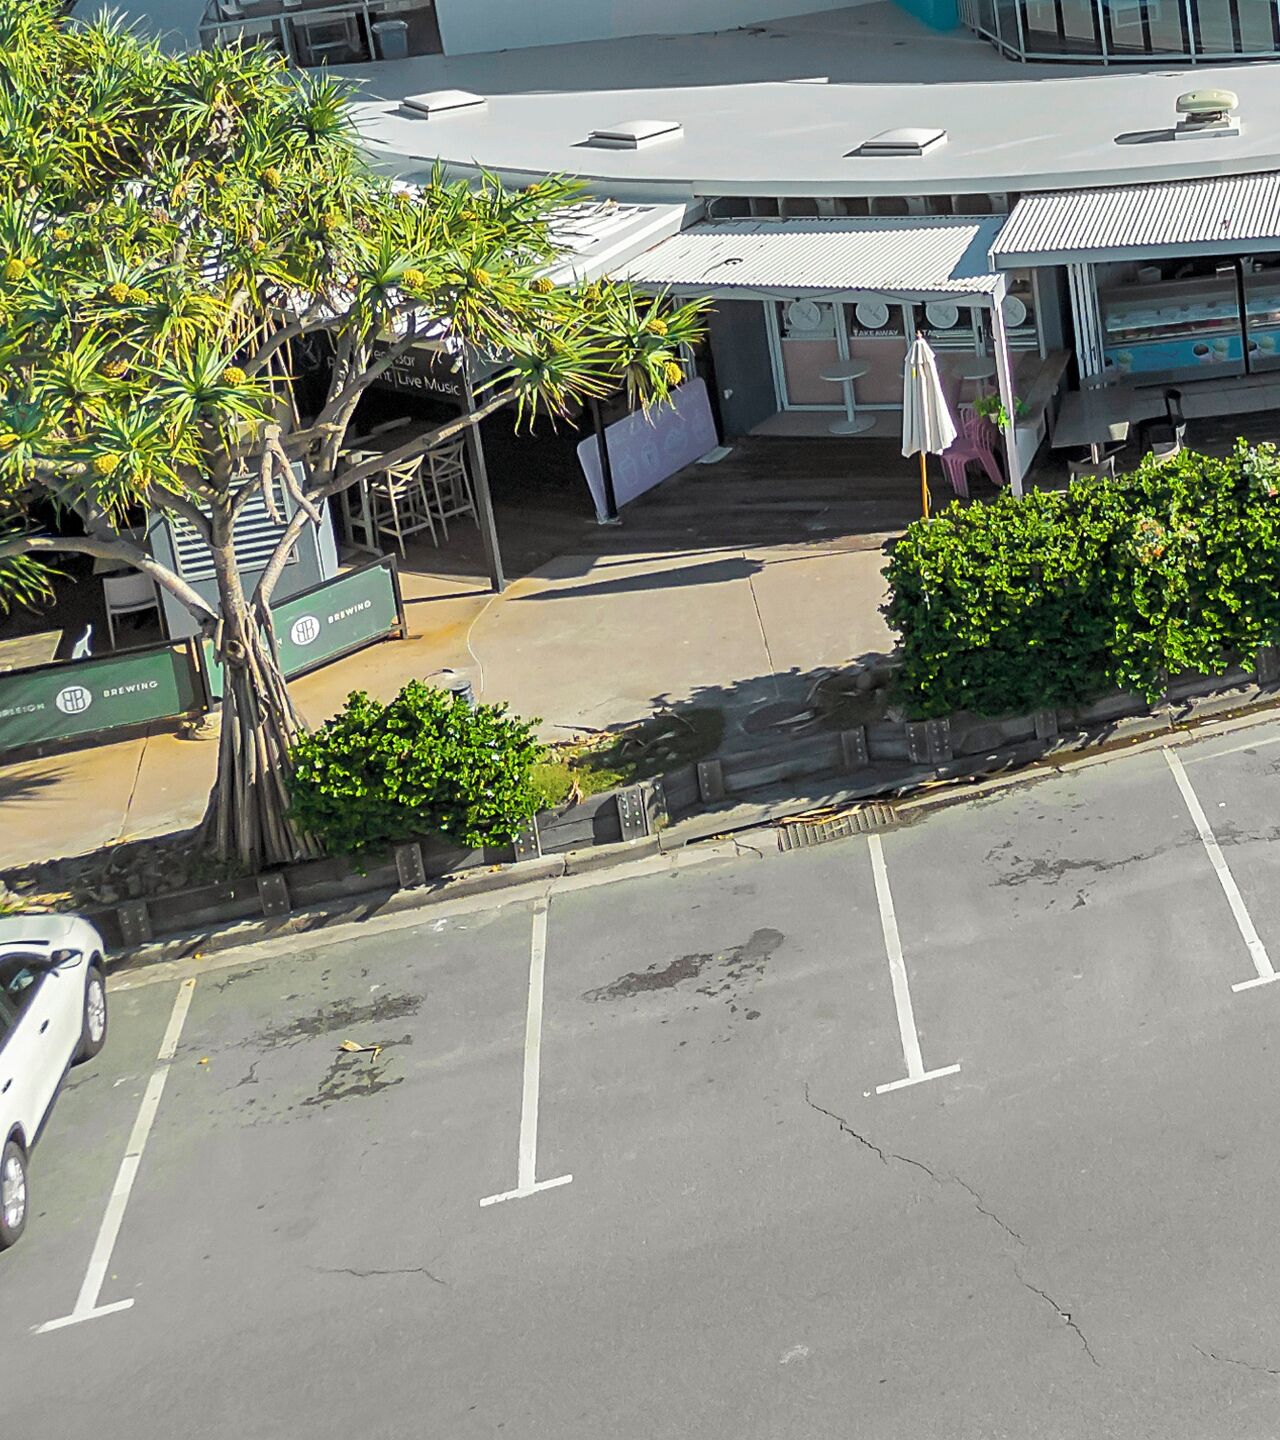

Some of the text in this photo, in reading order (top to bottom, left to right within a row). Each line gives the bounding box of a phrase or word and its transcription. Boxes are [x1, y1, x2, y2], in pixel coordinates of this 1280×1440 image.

[853, 328, 899, 337] TAKEAWAY
[398, 370, 422, 388] Live
[424, 376, 461, 396] Music
[327, 600, 372, 624] BREWING
[103, 680, 158, 698] BREWING
